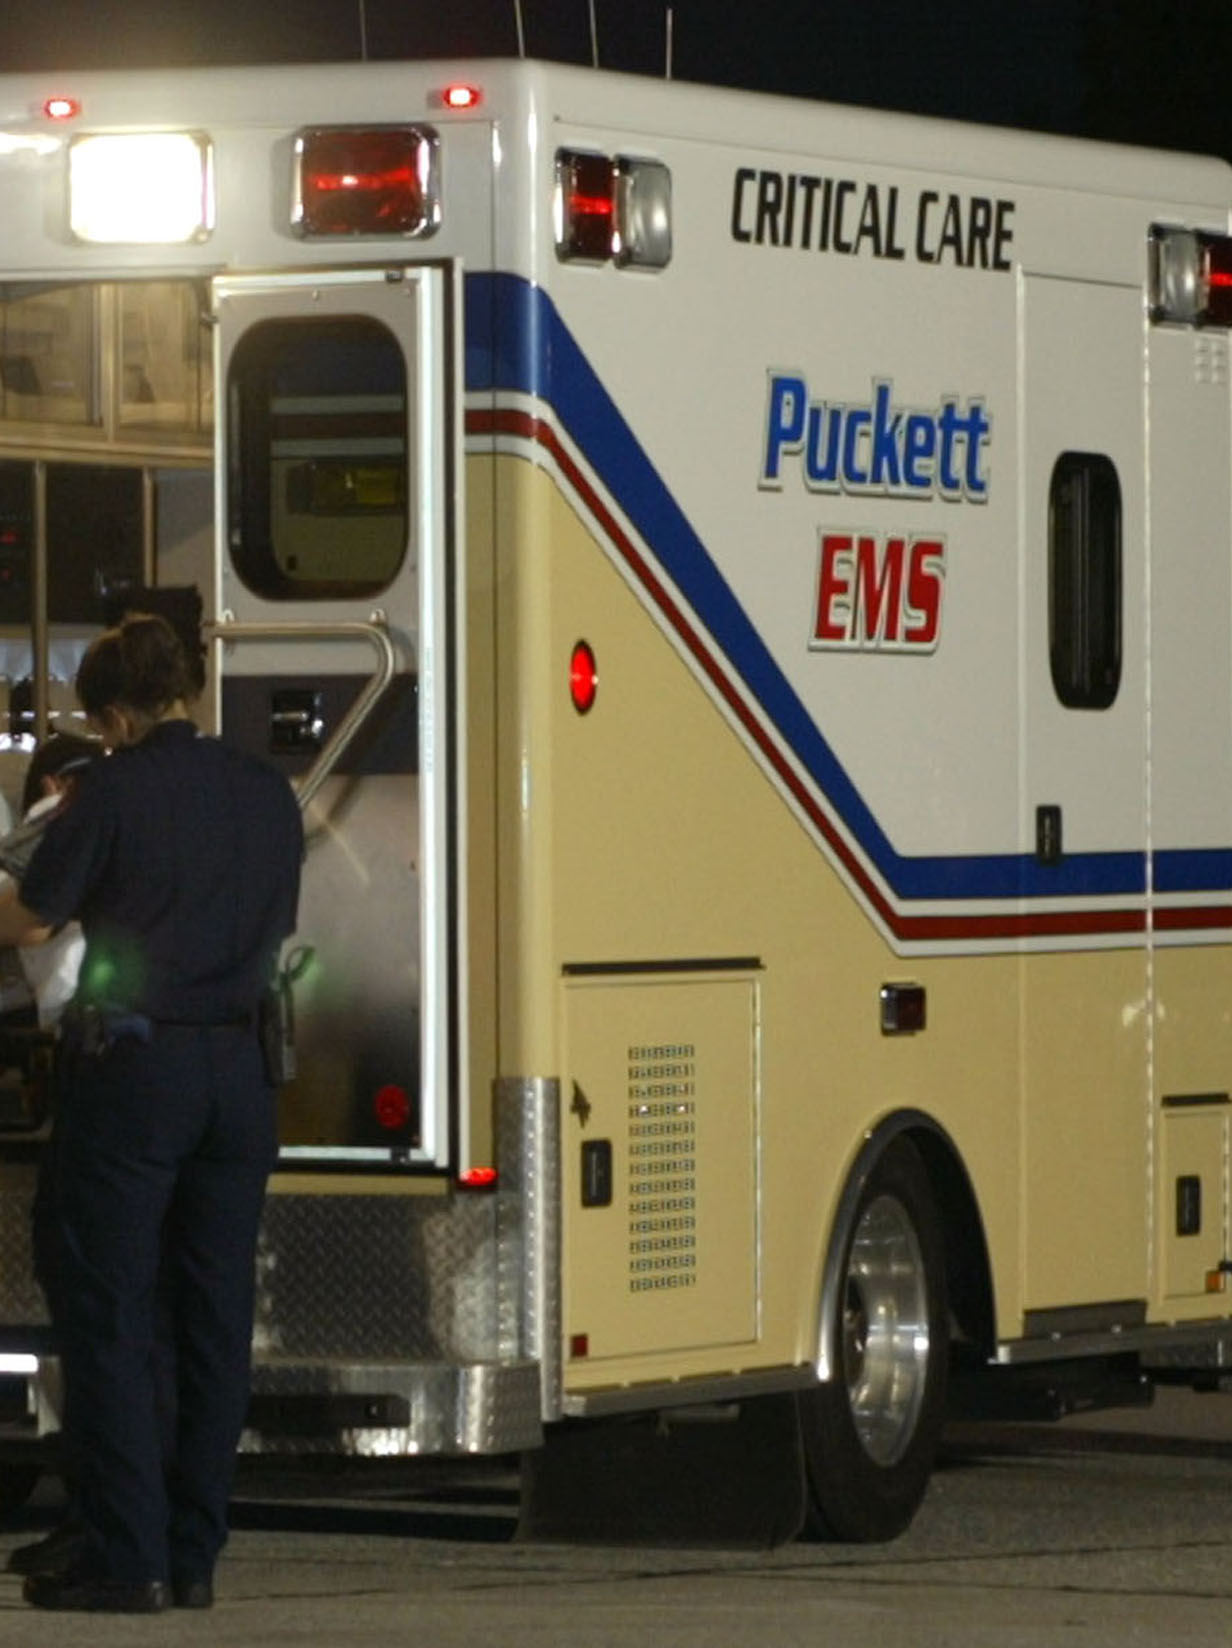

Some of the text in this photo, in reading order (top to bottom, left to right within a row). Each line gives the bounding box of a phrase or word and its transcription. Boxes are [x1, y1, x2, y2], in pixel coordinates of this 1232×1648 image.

[731, 167, 1015, 271] CRITICAL CARE
[760, 370, 990, 503] Puckett
[809, 530, 946, 654] EMS
